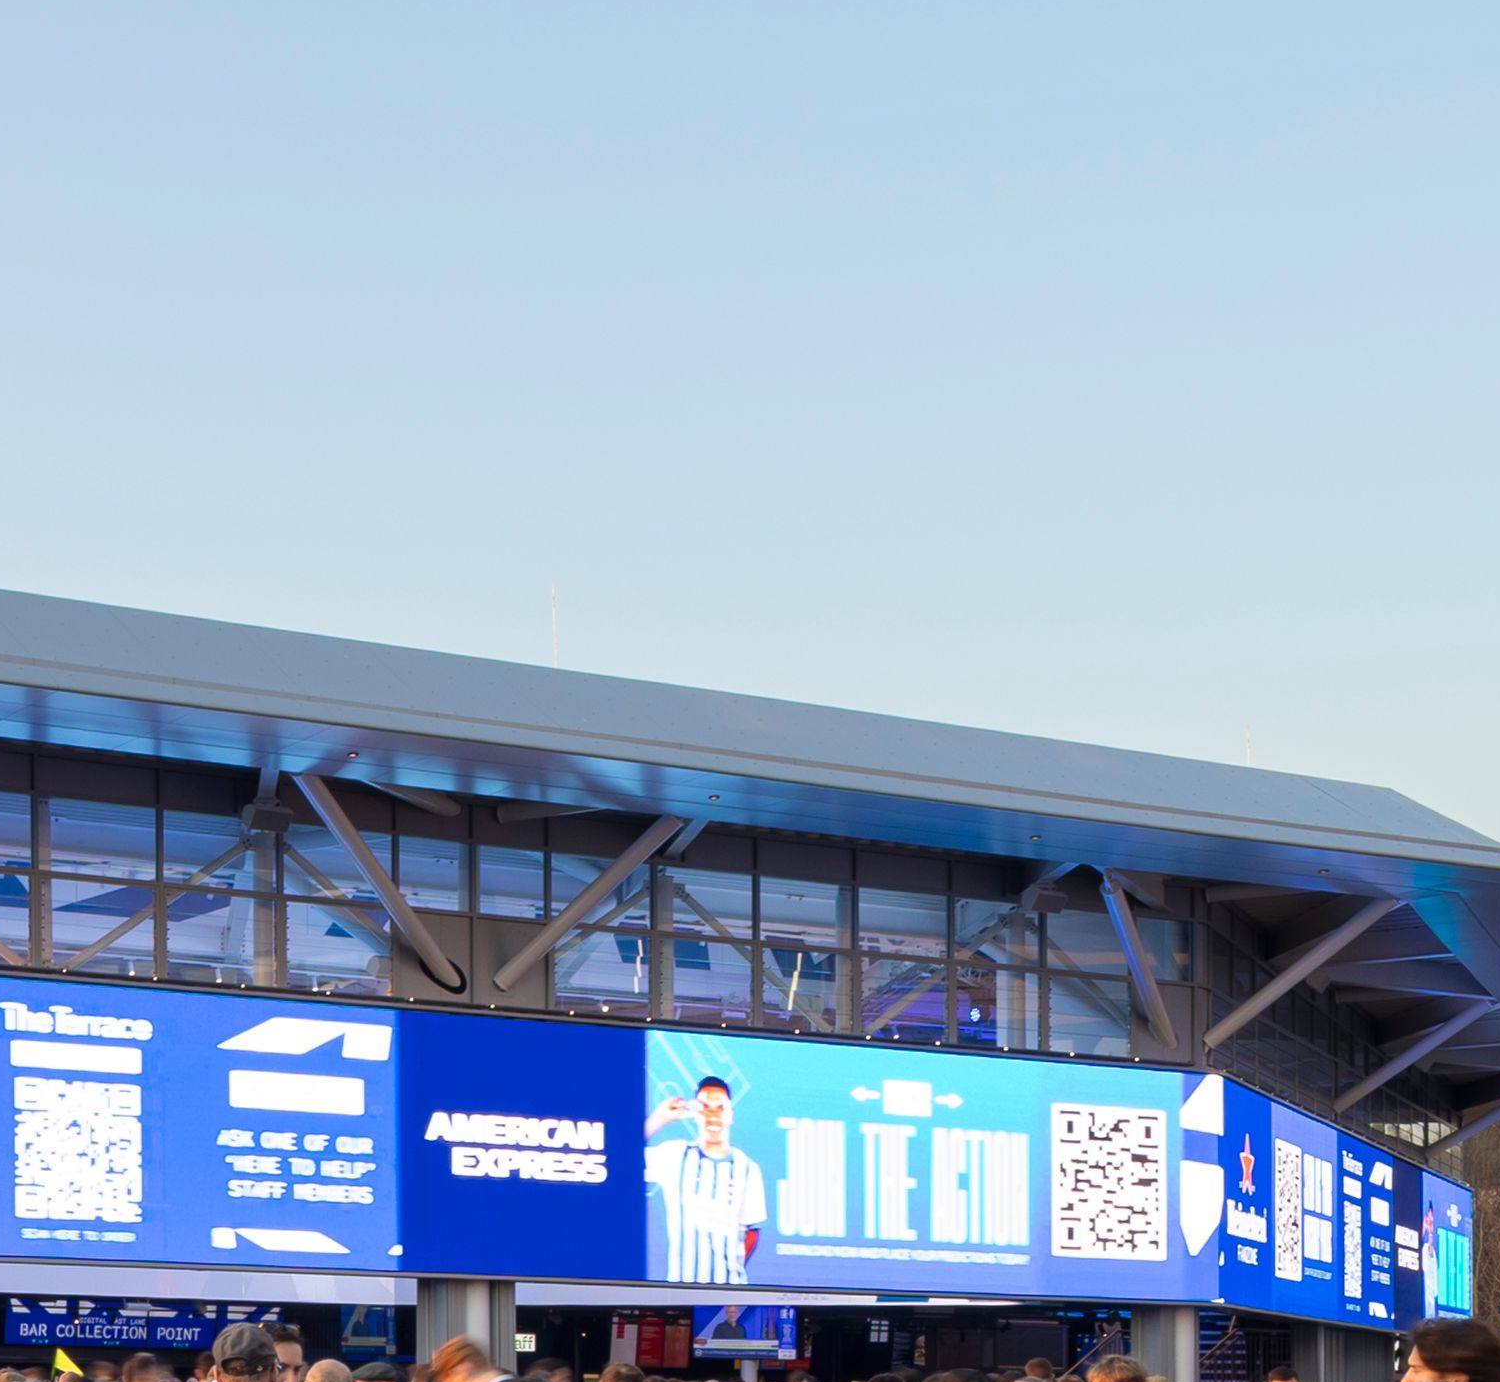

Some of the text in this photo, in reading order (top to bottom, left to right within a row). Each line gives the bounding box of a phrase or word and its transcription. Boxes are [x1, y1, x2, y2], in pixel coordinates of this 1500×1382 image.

[0, 1001, 154, 1042] The Terrace
[424, 1111, 605, 1151] AMERICAN
[260, 1132, 298, 1151] ONE
[304, 1134, 330, 1151] OF
[288, 1157, 316, 1176] TO
[451, 1146, 608, 1184] EXPRESS
[228, 1180, 288, 1198] STAFF
[19, 1323, 201, 1341] BAR COLLECTION POINT
[515, 1336, 534, 1350] aff
